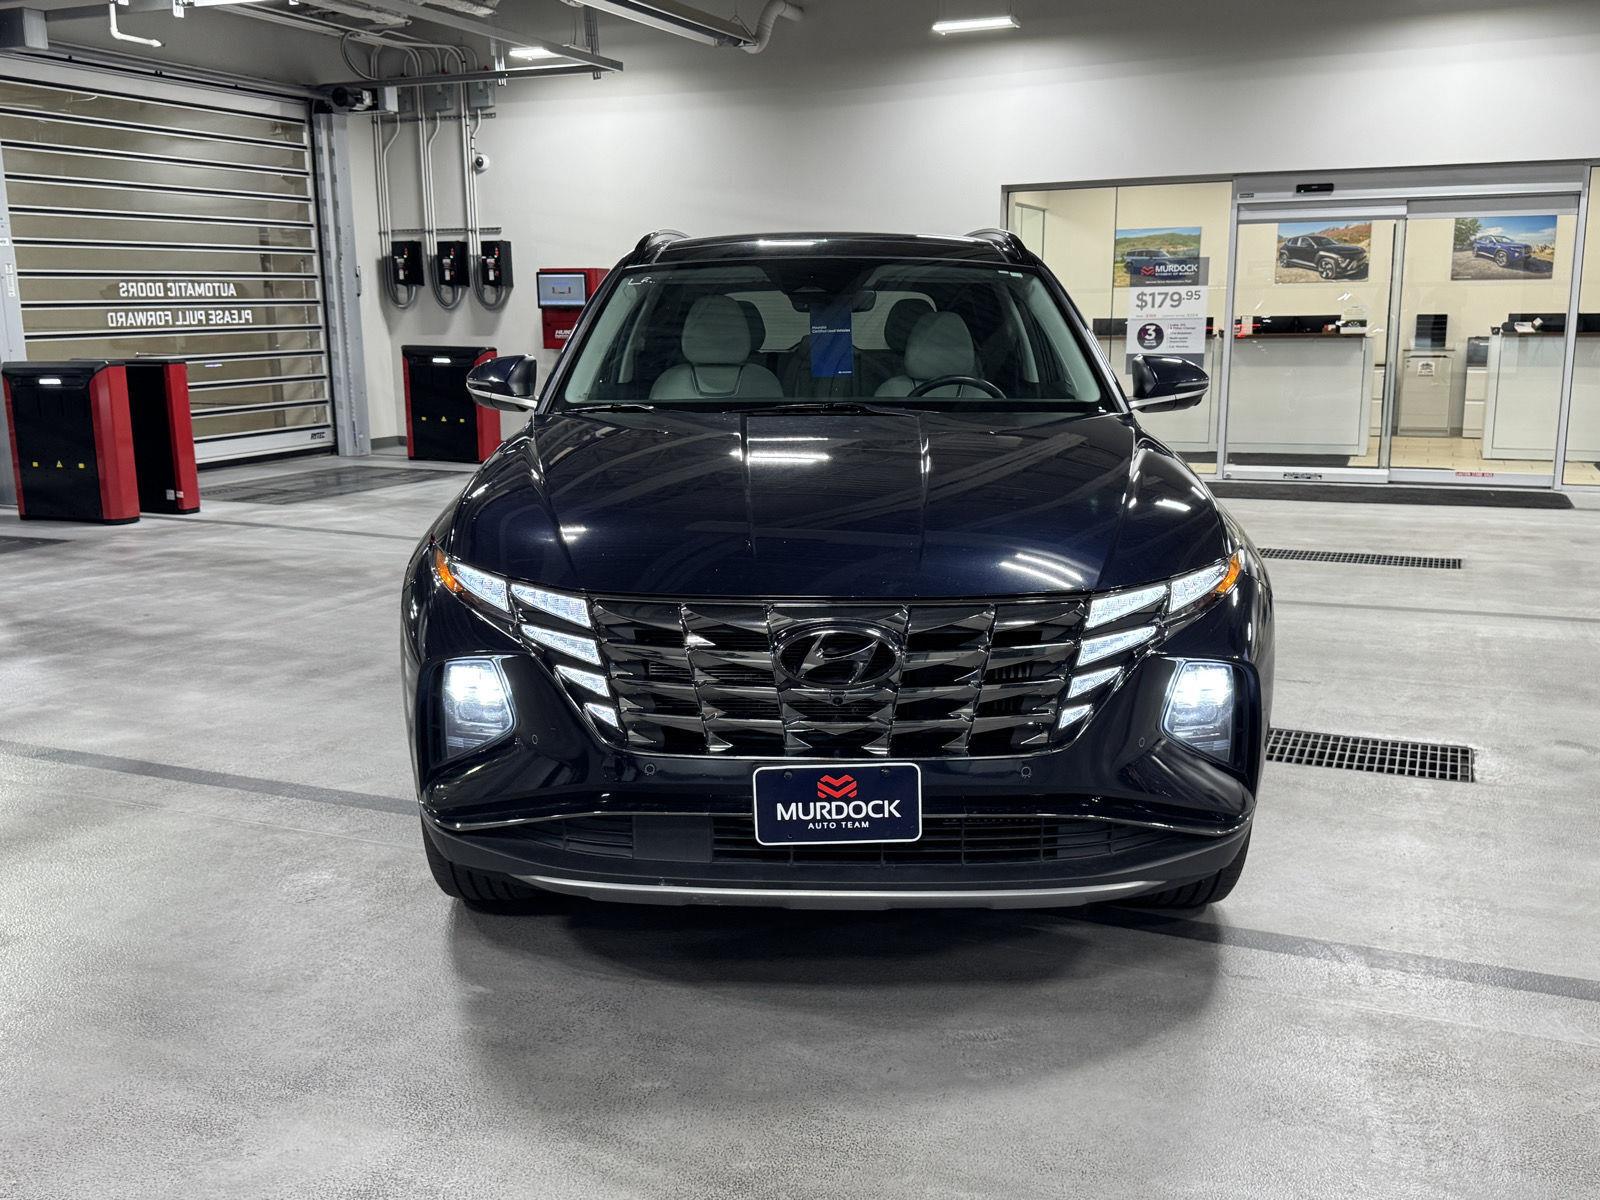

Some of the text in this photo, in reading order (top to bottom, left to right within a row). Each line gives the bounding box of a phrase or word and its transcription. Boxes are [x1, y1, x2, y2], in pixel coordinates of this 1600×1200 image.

[1155, 264, 1198, 273] MURDOCK
[1136, 290, 1200, 311] $179.95
[1144, 325, 1156, 340] 3
[776, 799, 902, 821] MURDOCK
[808, 821, 870, 830] AUTO TEAM
